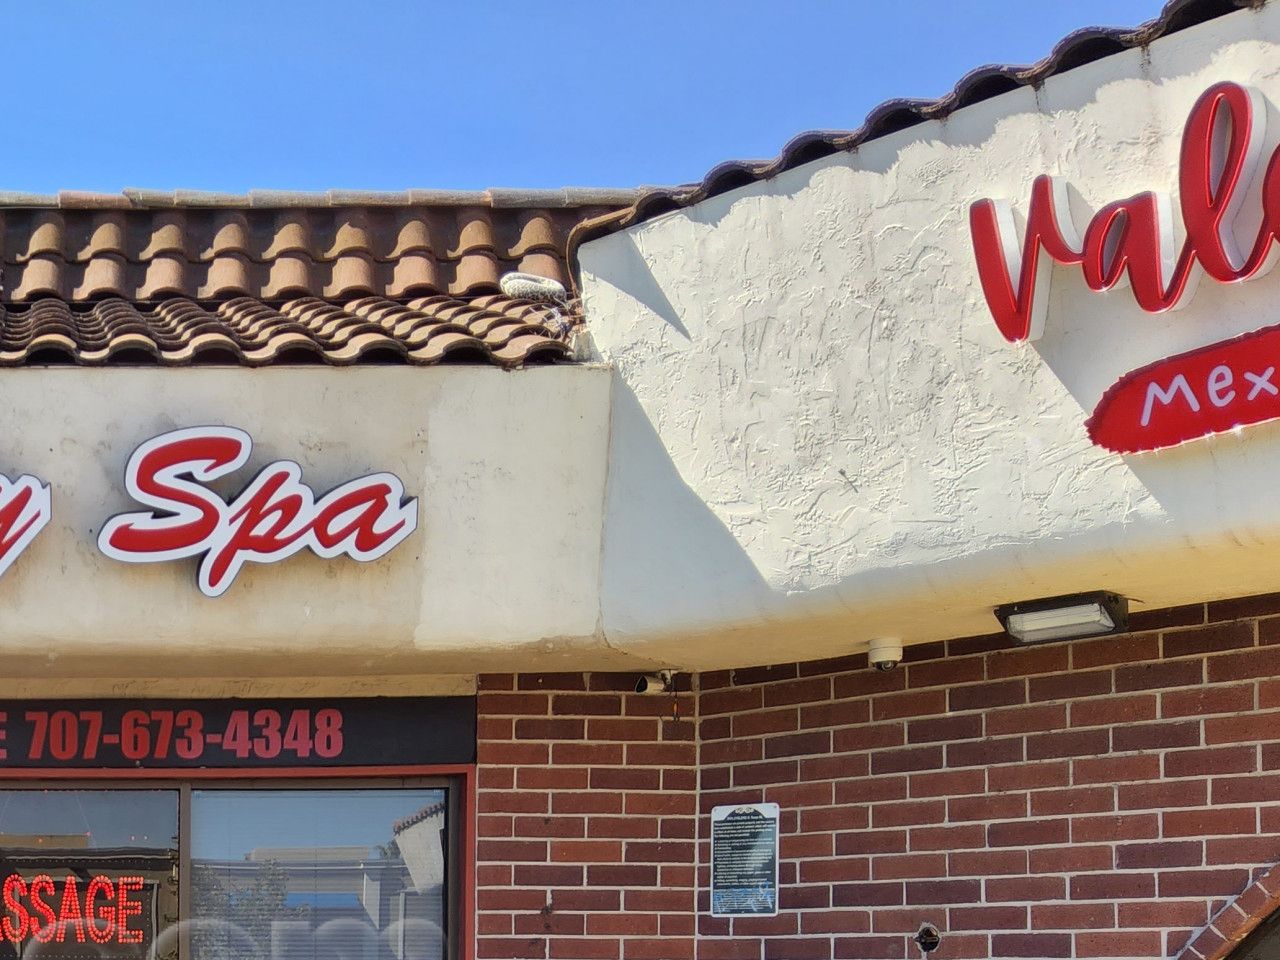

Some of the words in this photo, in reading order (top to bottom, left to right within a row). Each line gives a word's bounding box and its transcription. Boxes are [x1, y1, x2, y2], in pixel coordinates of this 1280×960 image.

[970, 81, 1280, 343] Val
[1140, 363, 1279, 427] Mex
[101, 428, 415, 594] Spa
[24, 708, 345, 761] 707-673-4348
